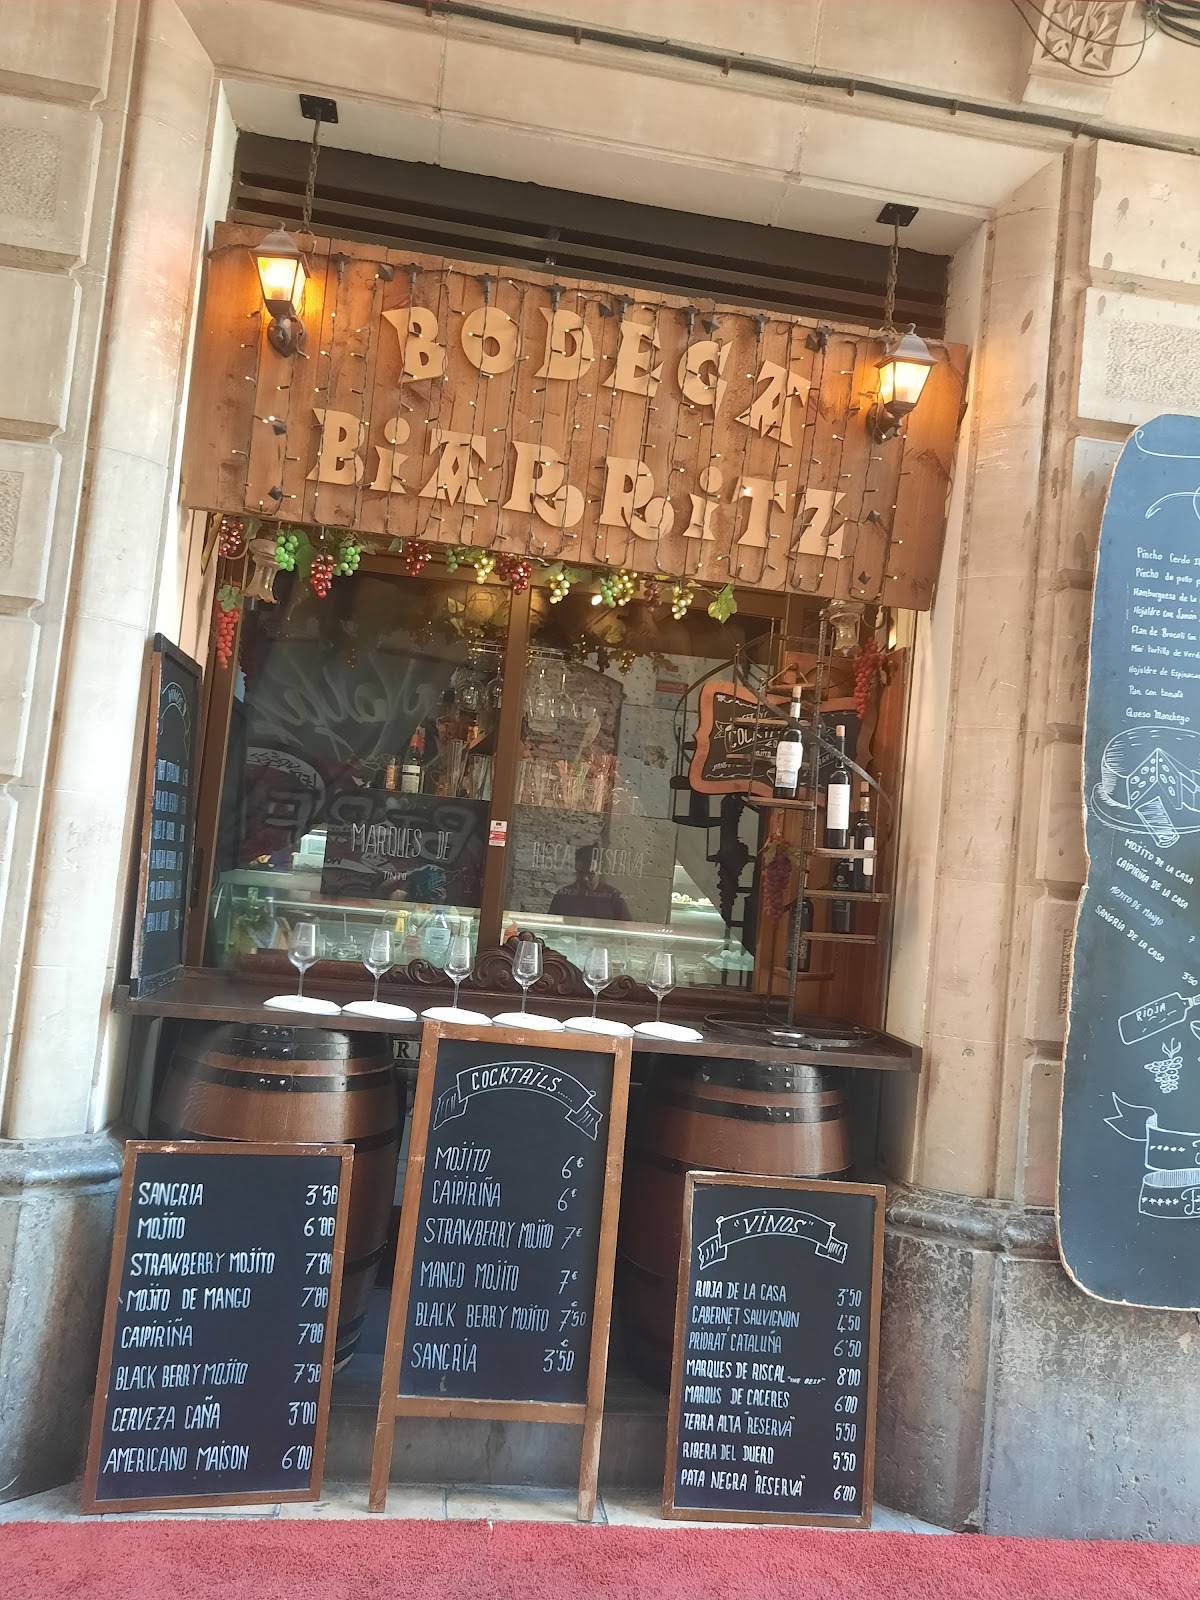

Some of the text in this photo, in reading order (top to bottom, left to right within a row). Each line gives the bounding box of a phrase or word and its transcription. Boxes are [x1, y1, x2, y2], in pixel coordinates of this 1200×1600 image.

[382, 306, 811, 447] BODEGA
[1136, 546, 1163, 560] Pincho
[1169, 552, 1190, 564] Cerdo
[1179, 592, 1188, 602] de
[1125, 706, 1151, 718] Queso
[436, 830, 453, 861] DE
[1154, 856, 1164, 868] DE
[1165, 864, 1175, 875] LA
[1174, 869, 1195, 886] CASA
[1150, 879, 1162, 892] DE
[1161, 887, 1172, 898] LA
[1171, 894, 1189, 910] CASA
[1126, 929, 1138, 942] DE
[1137, 938, 1148, 950] LA
[1147, 947, 1165, 963] CASA
[138, 1182, 204, 1207] SANGRIA
[423, 1217, 516, 1249] STRAWBERRY
[130, 1251, 225, 1276] STRAWBERRY
[420, 1261, 465, 1289] MANGO
[182, 1288, 196, 1310] DE
[203, 1287, 251, 1311] MANGO
[695, 1280, 723, 1299] RIOJA
[726, 1281, 740, 1300] DE
[743, 1283, 756, 1300] LA
[760, 1283, 787, 1302] CASA
[415, 1302, 456, 1328] BLACK
[466, 1304, 508, 1329] BERRY
[691, 1305, 741, 1325] CABERNET
[743, 1308, 800, 1328] SAUVIGNON
[115, 1365, 156, 1391] BLACK
[161, 1363, 201, 1388] BERRY
[686, 1359, 732, 1379] MARQUES
[735, 1361, 749, 1380] DE
[751, 1362, 786, 1384] RISCAL
[730, 1387, 744, 1405] DE
[746, 1389, 790, 1409] CACERES
[111, 1406, 175, 1432] CERVEZA
[184, 1396, 221, 1430] CAÑA
[683, 1412, 714, 1432] TERRA
[716, 1414, 742, 1434] ALTA
[102, 1445, 187, 1474] AMERICANO
[682, 1441, 717, 1460] RIBERA
[720, 1444, 737, 1461] DEL
[742, 1445, 774, 1465] DUERO
[680, 1468, 706, 1488] PATA
[710, 1471, 748, 1492] NEGRA
